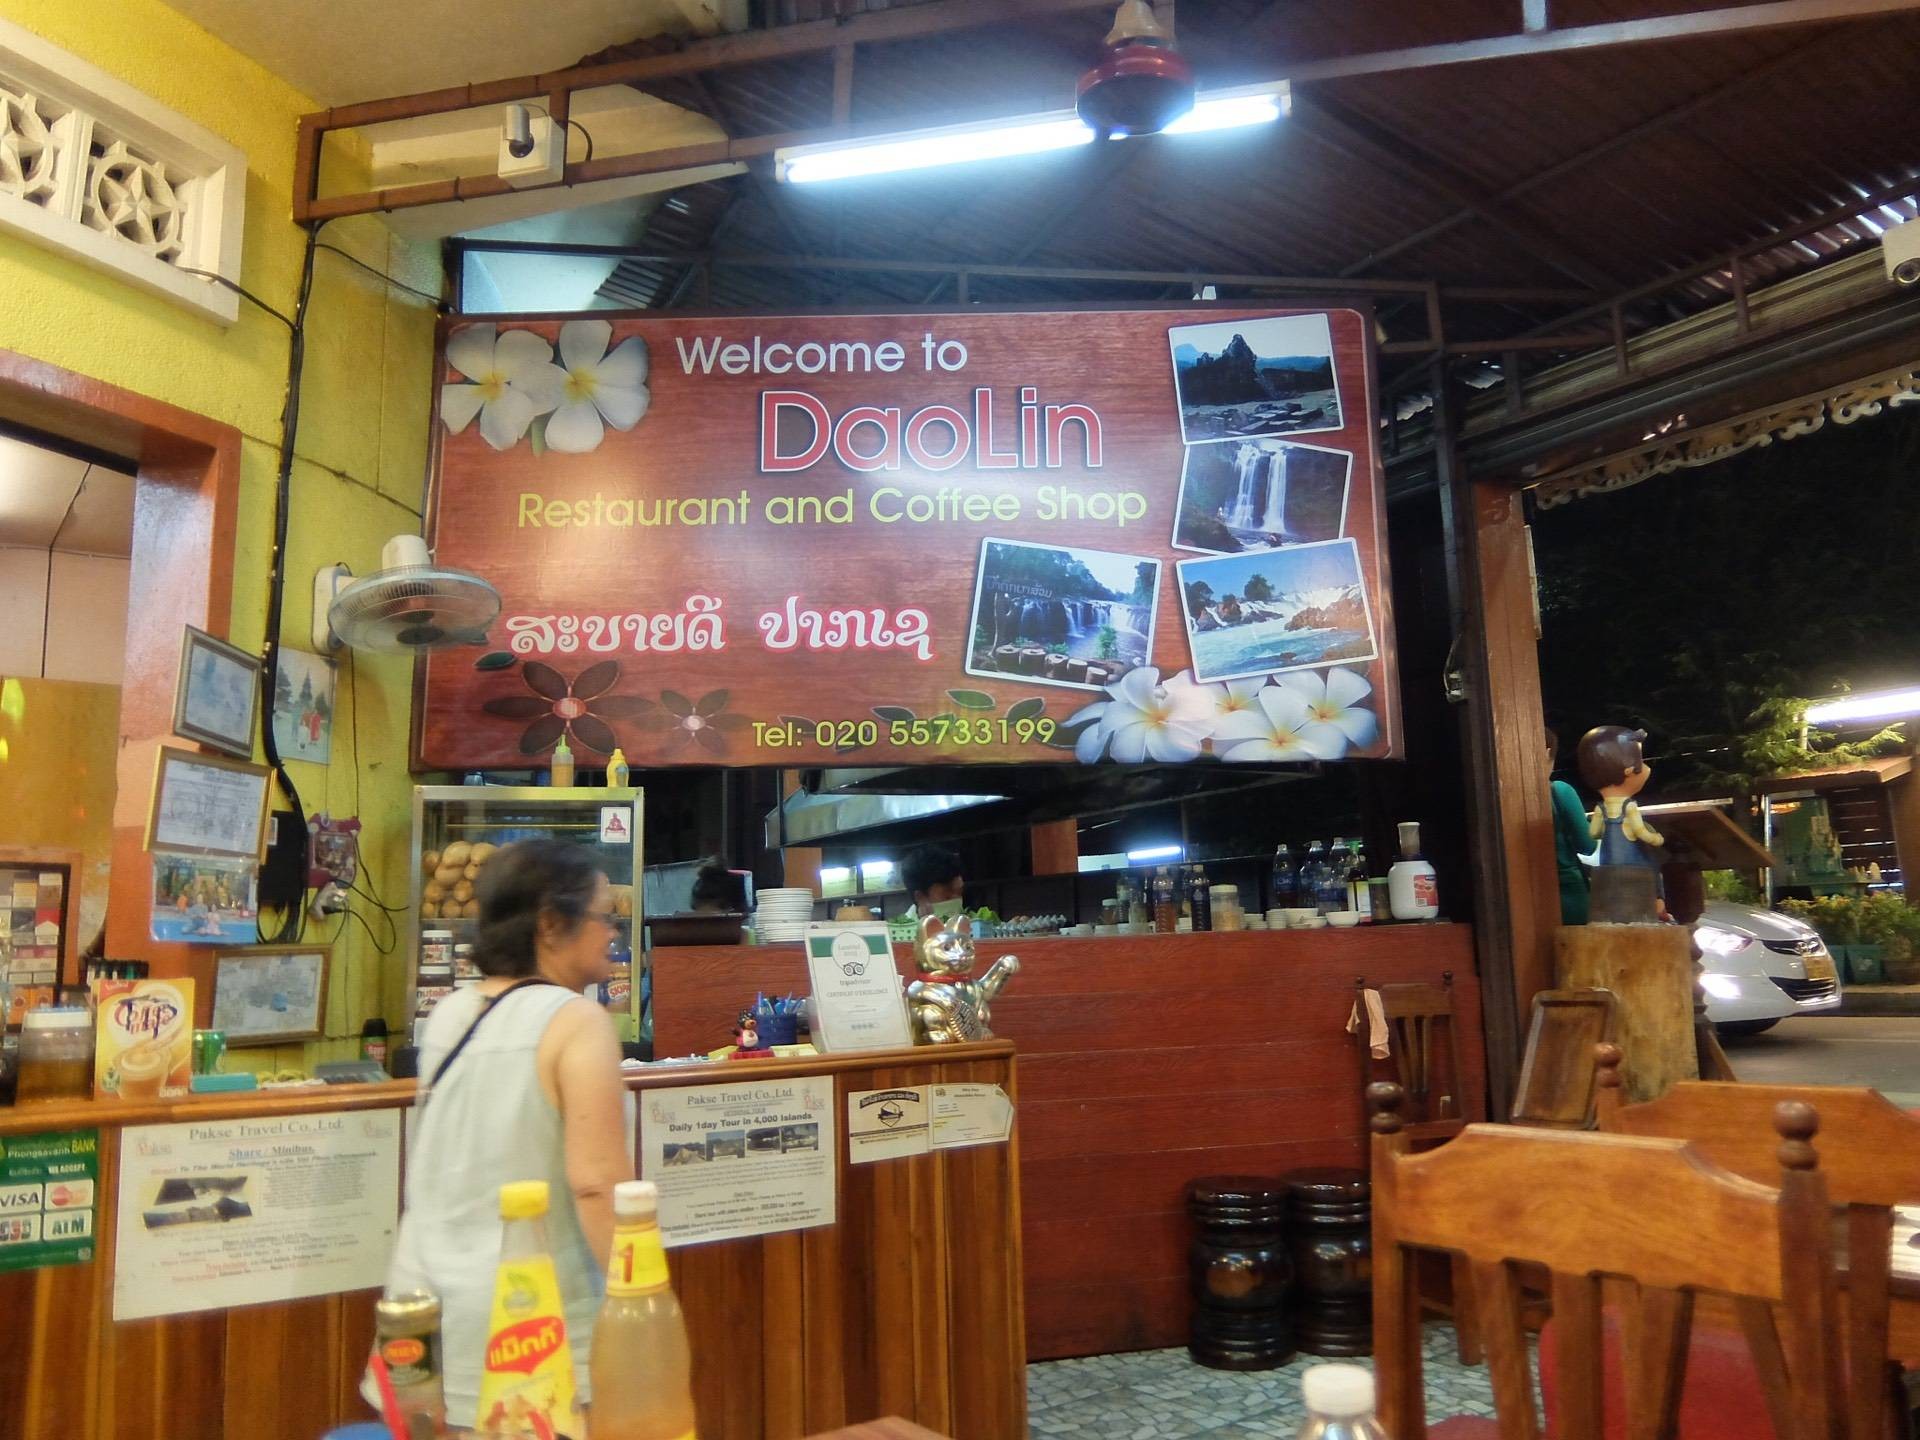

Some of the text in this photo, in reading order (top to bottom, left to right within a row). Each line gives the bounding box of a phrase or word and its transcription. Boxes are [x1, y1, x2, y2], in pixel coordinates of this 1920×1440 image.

[676, 333, 968, 374] Welcome to
[760, 387, 1103, 472] DaoLin
[518, 485, 1148, 528] Restaurant and Coffee Shop
[505, 594, 726, 653] ສະບາຍດີ
[752, 718, 1056, 747] Tel: 020 55733199
[609, 982, 631, 996] SKIPP
[687, 1092, 718, 1106] Pakse
[720, 1089, 757, 1103] Travel
[189, 1127, 233, 1140] Pakse
[238, 1123, 283, 1137] Travel
[669, 1112, 813, 1133] Daily 1day Tour in 4,000 Islands
[71, 1139, 96, 1154] BANK
[228, 1147, 263, 1160] Share
[0, 1192, 39, 1207] VISA
[52, 1216, 85, 1235] ATM
